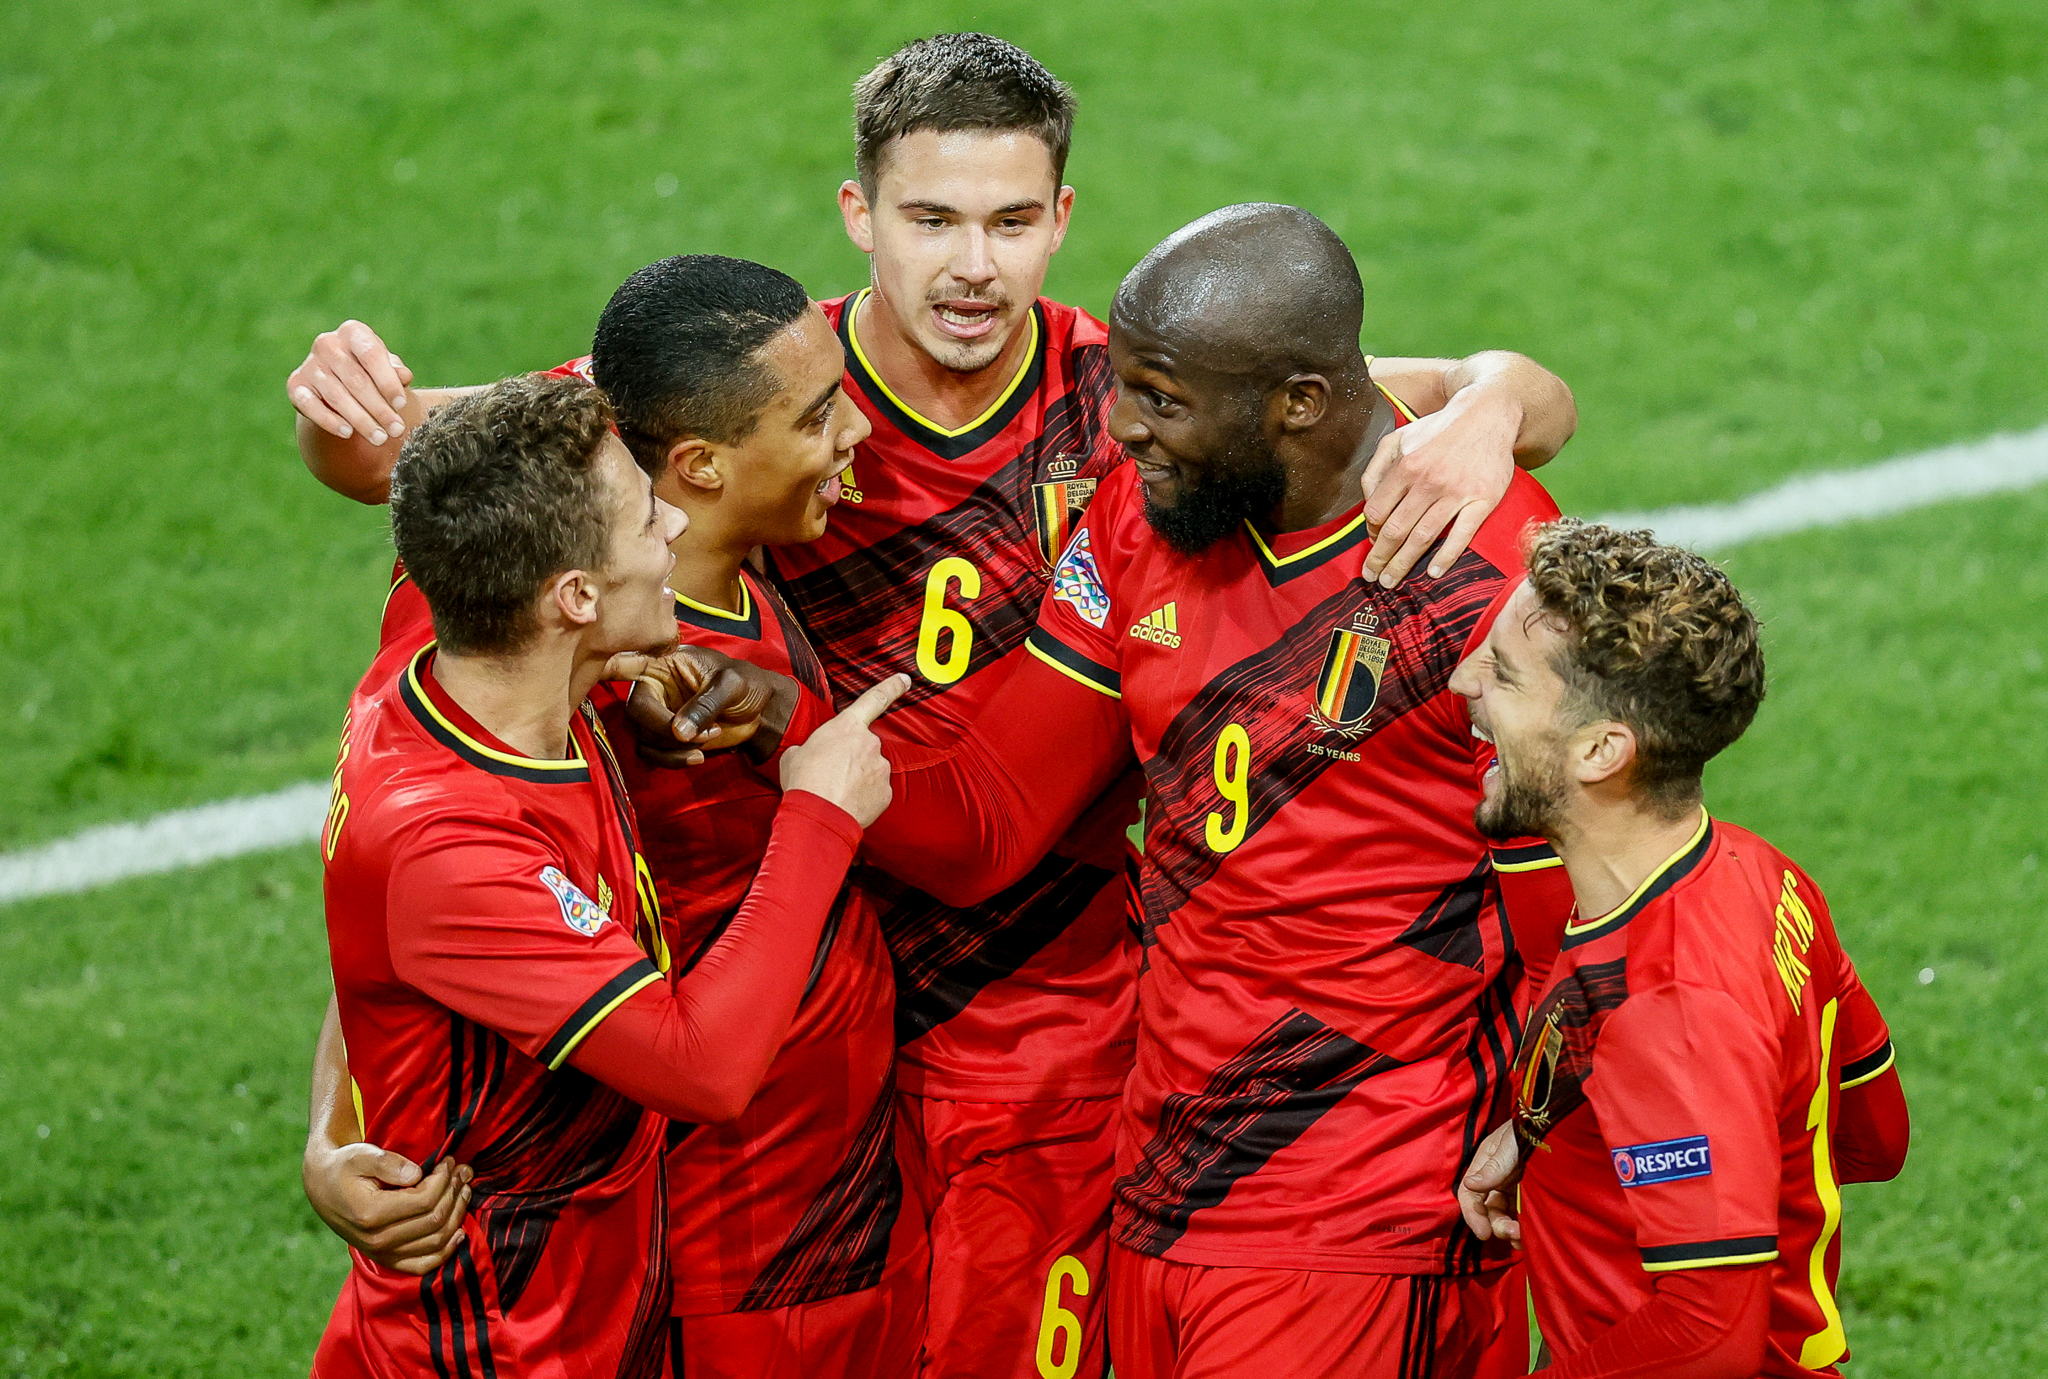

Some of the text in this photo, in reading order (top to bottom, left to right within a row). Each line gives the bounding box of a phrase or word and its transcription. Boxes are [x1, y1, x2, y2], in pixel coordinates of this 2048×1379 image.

[1067, 489, 1095, 497] BELGIAN
[916, 557, 981, 684] 6
[1129, 623, 1182, 649] adidas
[1361, 637, 1381, 648] ROYAL
[1358, 644, 1387, 657] BELGIAN
[1306, 743, 1361, 762] 125 YEARS
[1205, 723, 1250, 853] 9
[1635, 1146, 1709, 1175] RESPECT
[1036, 1254, 1090, 1379] 6
